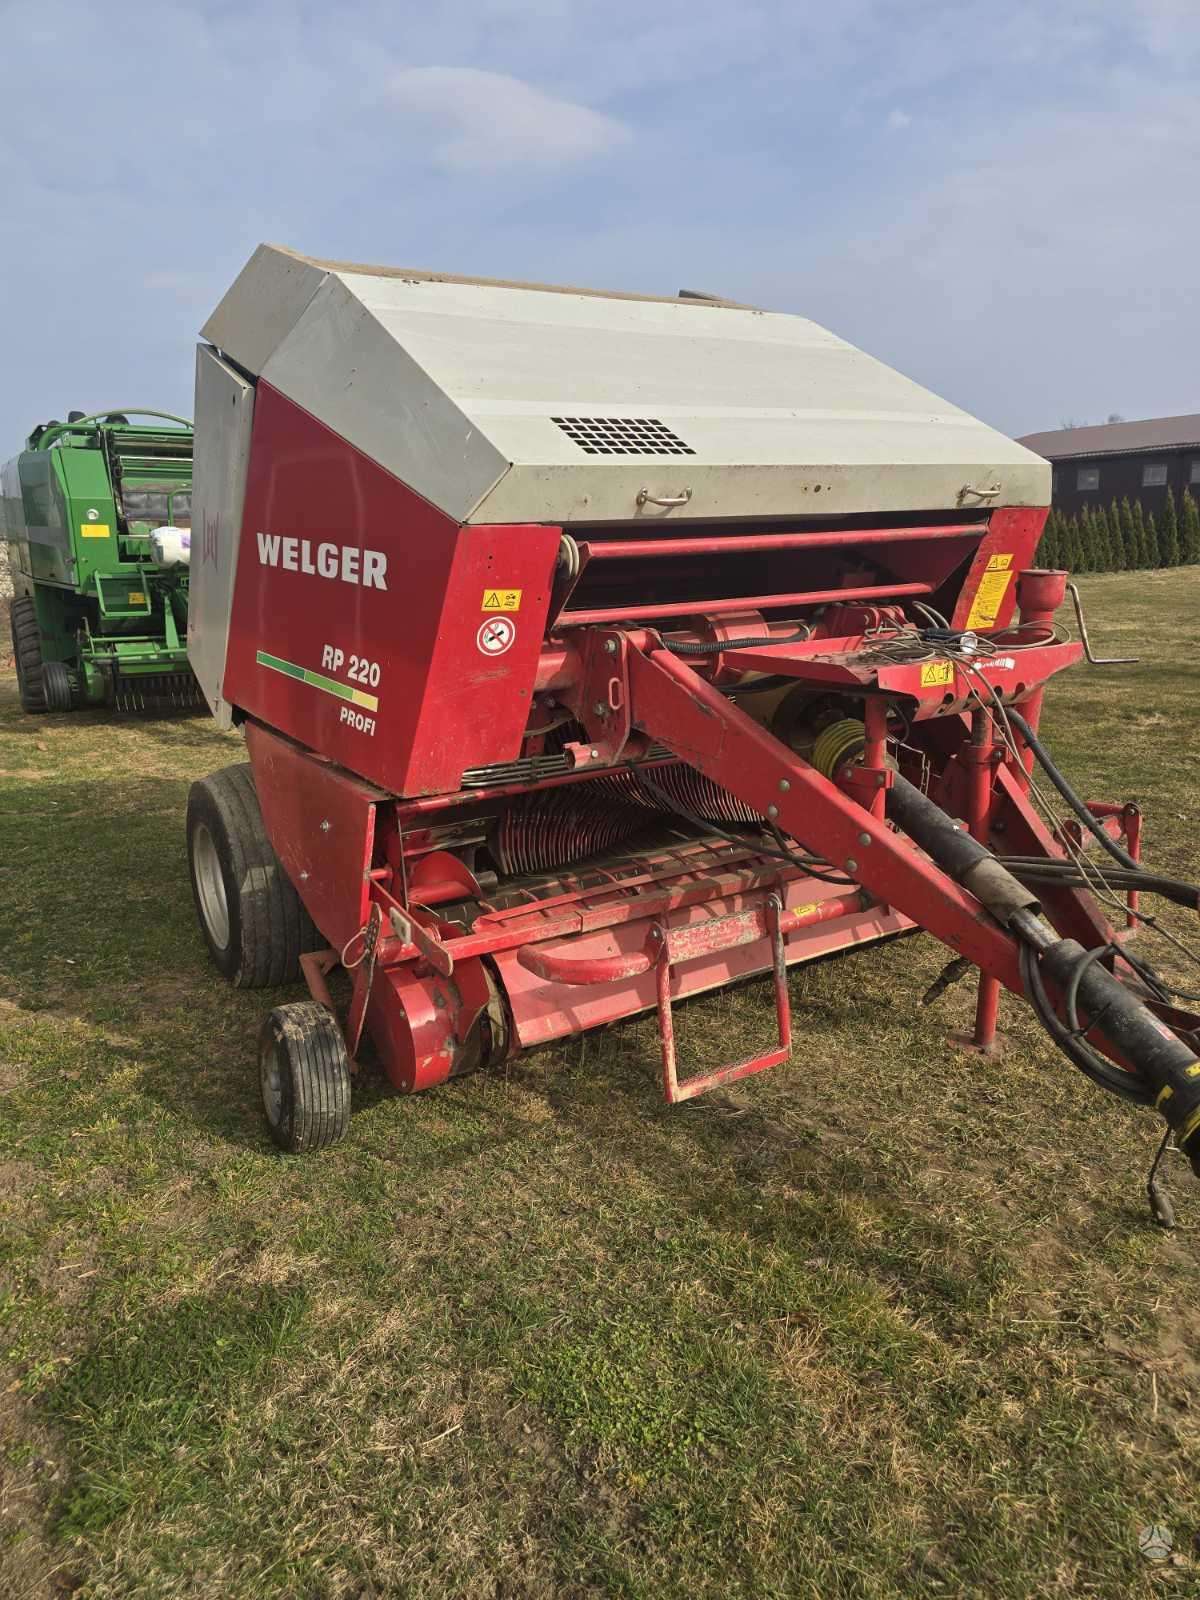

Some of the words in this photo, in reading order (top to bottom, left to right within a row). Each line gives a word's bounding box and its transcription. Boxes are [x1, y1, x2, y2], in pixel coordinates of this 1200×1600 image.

[256, 532, 388, 591] WELGER
[321, 643, 345, 672] RP
[347, 654, 381, 688] 220
[339, 706, 376, 737] PROFI
